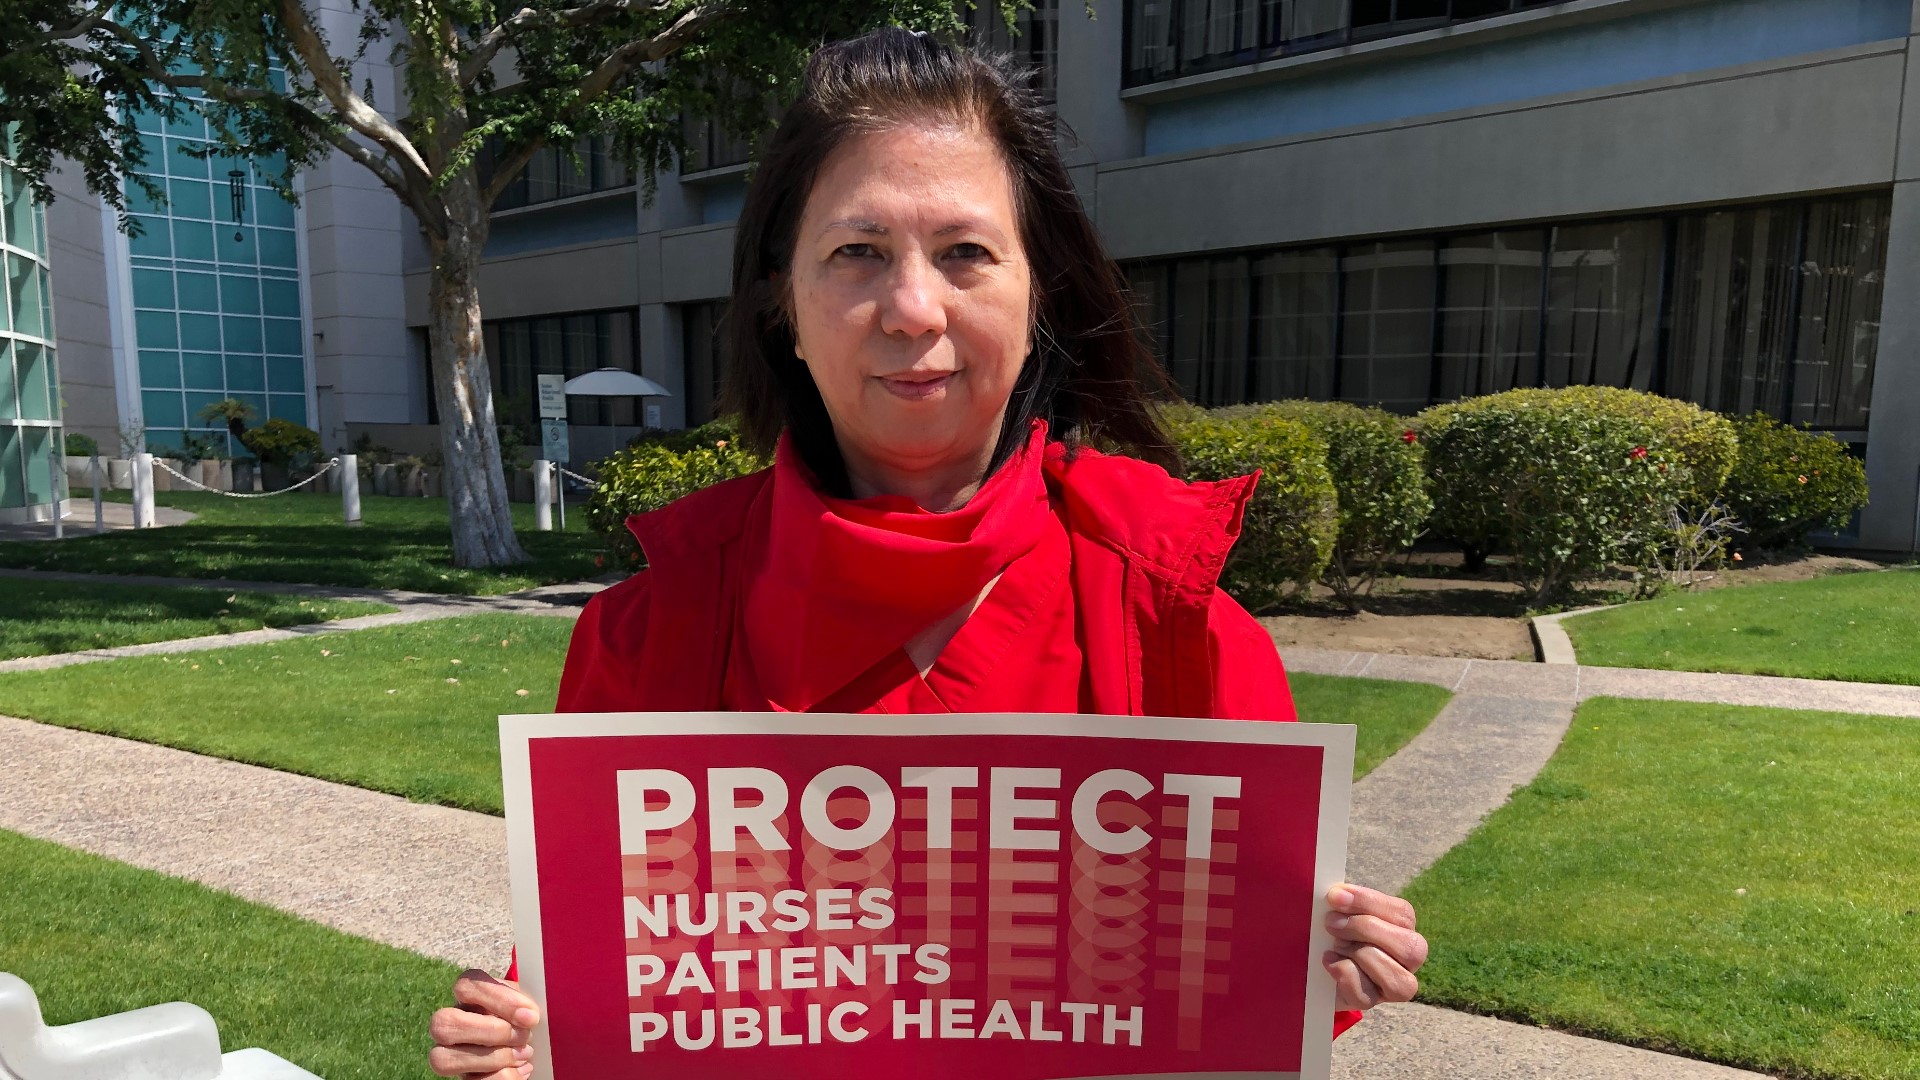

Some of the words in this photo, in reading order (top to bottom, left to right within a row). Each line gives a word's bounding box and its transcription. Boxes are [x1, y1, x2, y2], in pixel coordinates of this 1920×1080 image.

[617, 765, 1242, 859] PROTECT
[624, 887, 895, 939] NURSES
[627, 943, 951, 997] PATIENTS
[629, 1000, 869, 1052] PUBLIC
[892, 999, 1143, 1047] HEALTH
